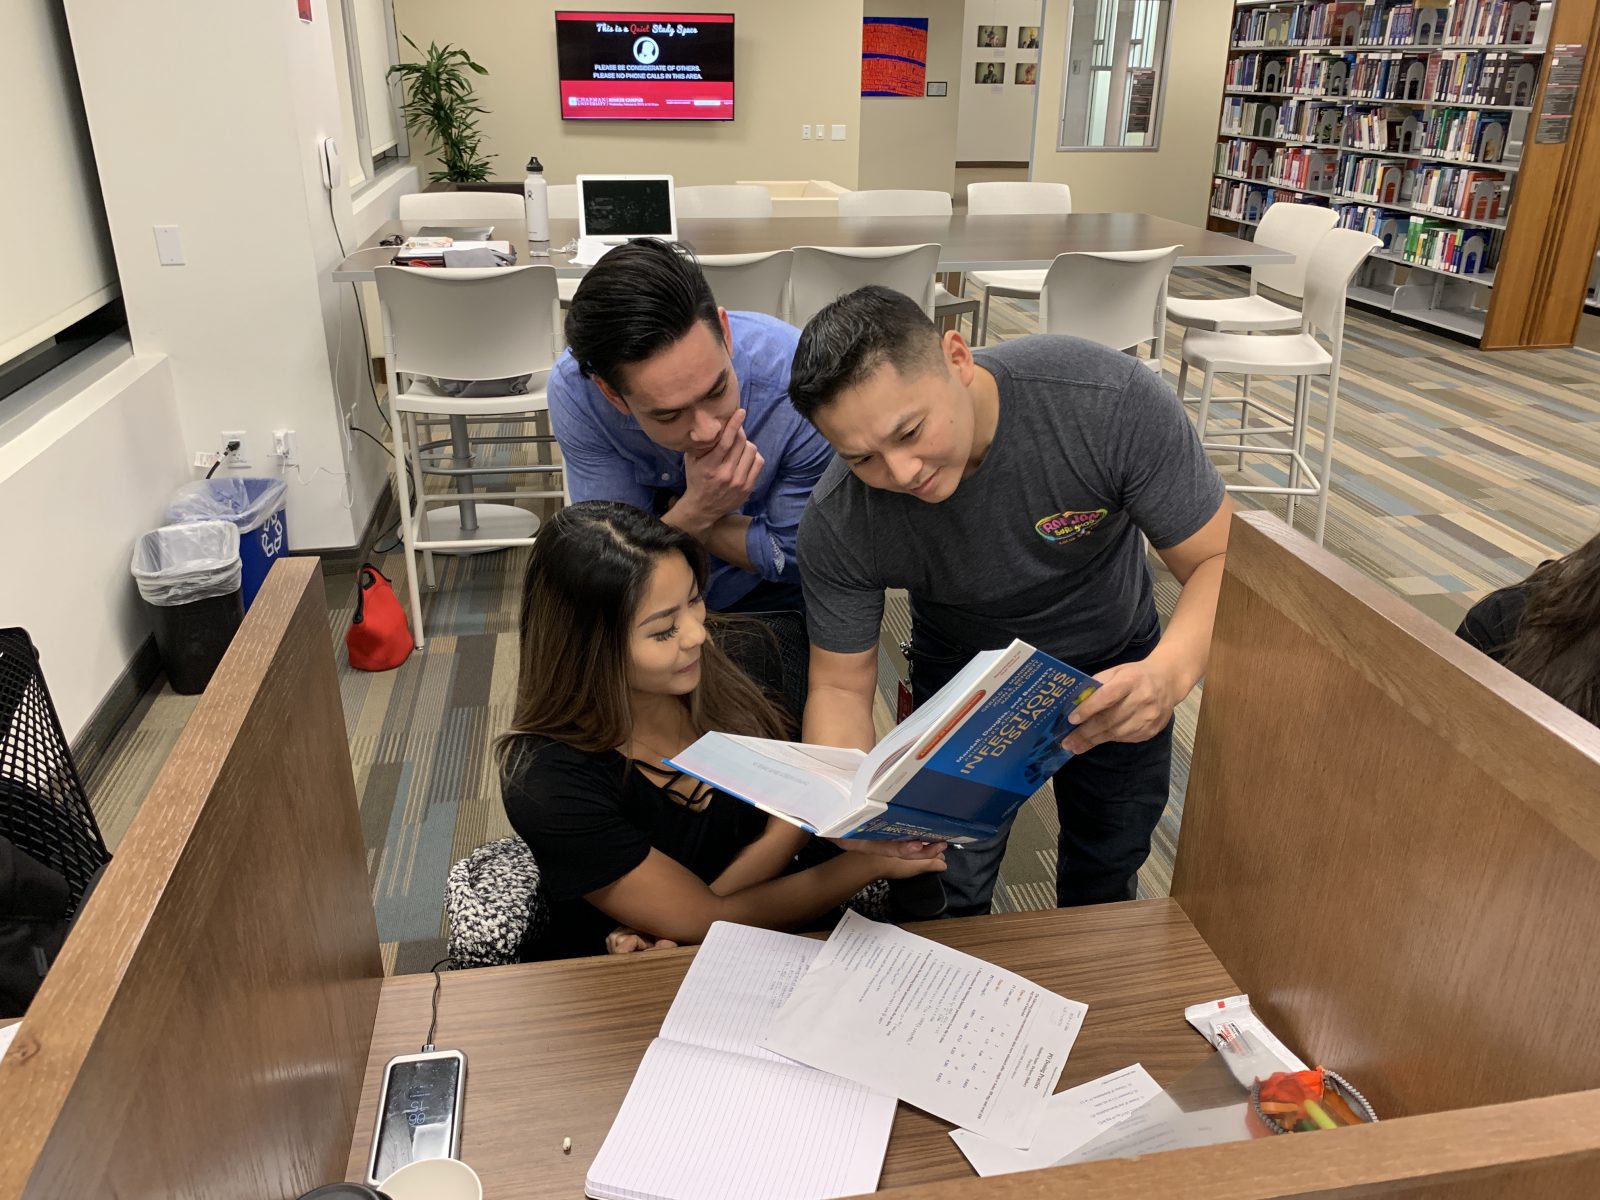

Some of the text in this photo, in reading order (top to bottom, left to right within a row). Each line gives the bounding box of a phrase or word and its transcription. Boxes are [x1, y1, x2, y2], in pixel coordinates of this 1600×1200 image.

[596, 22, 614, 32] This
[615, 24, 622, 32] is
[630, 24, 650, 34] Quiet
[652, 24, 675, 37] Study
[676, 24, 698, 36] Space
[980, 690, 1004, 711] GERALD
[1008, 658, 1036, 684] MANDELL
[1000, 679, 1026, 703] RAPHAEL
[1024, 662, 1043, 678] DOLIN
[1009, 696, 1023, 708] and
[1021, 667, 1053, 695] Bennett's
[1013, 660, 1039, 684] BENNETT
[959, 673, 1068, 772] INFECTIOUS
[963, 669, 1058, 760] PRINCIPLES AND PRACTICE OF
[990, 676, 1077, 756] DISEASES
[1034, 1073, 1045, 1089] Practice
